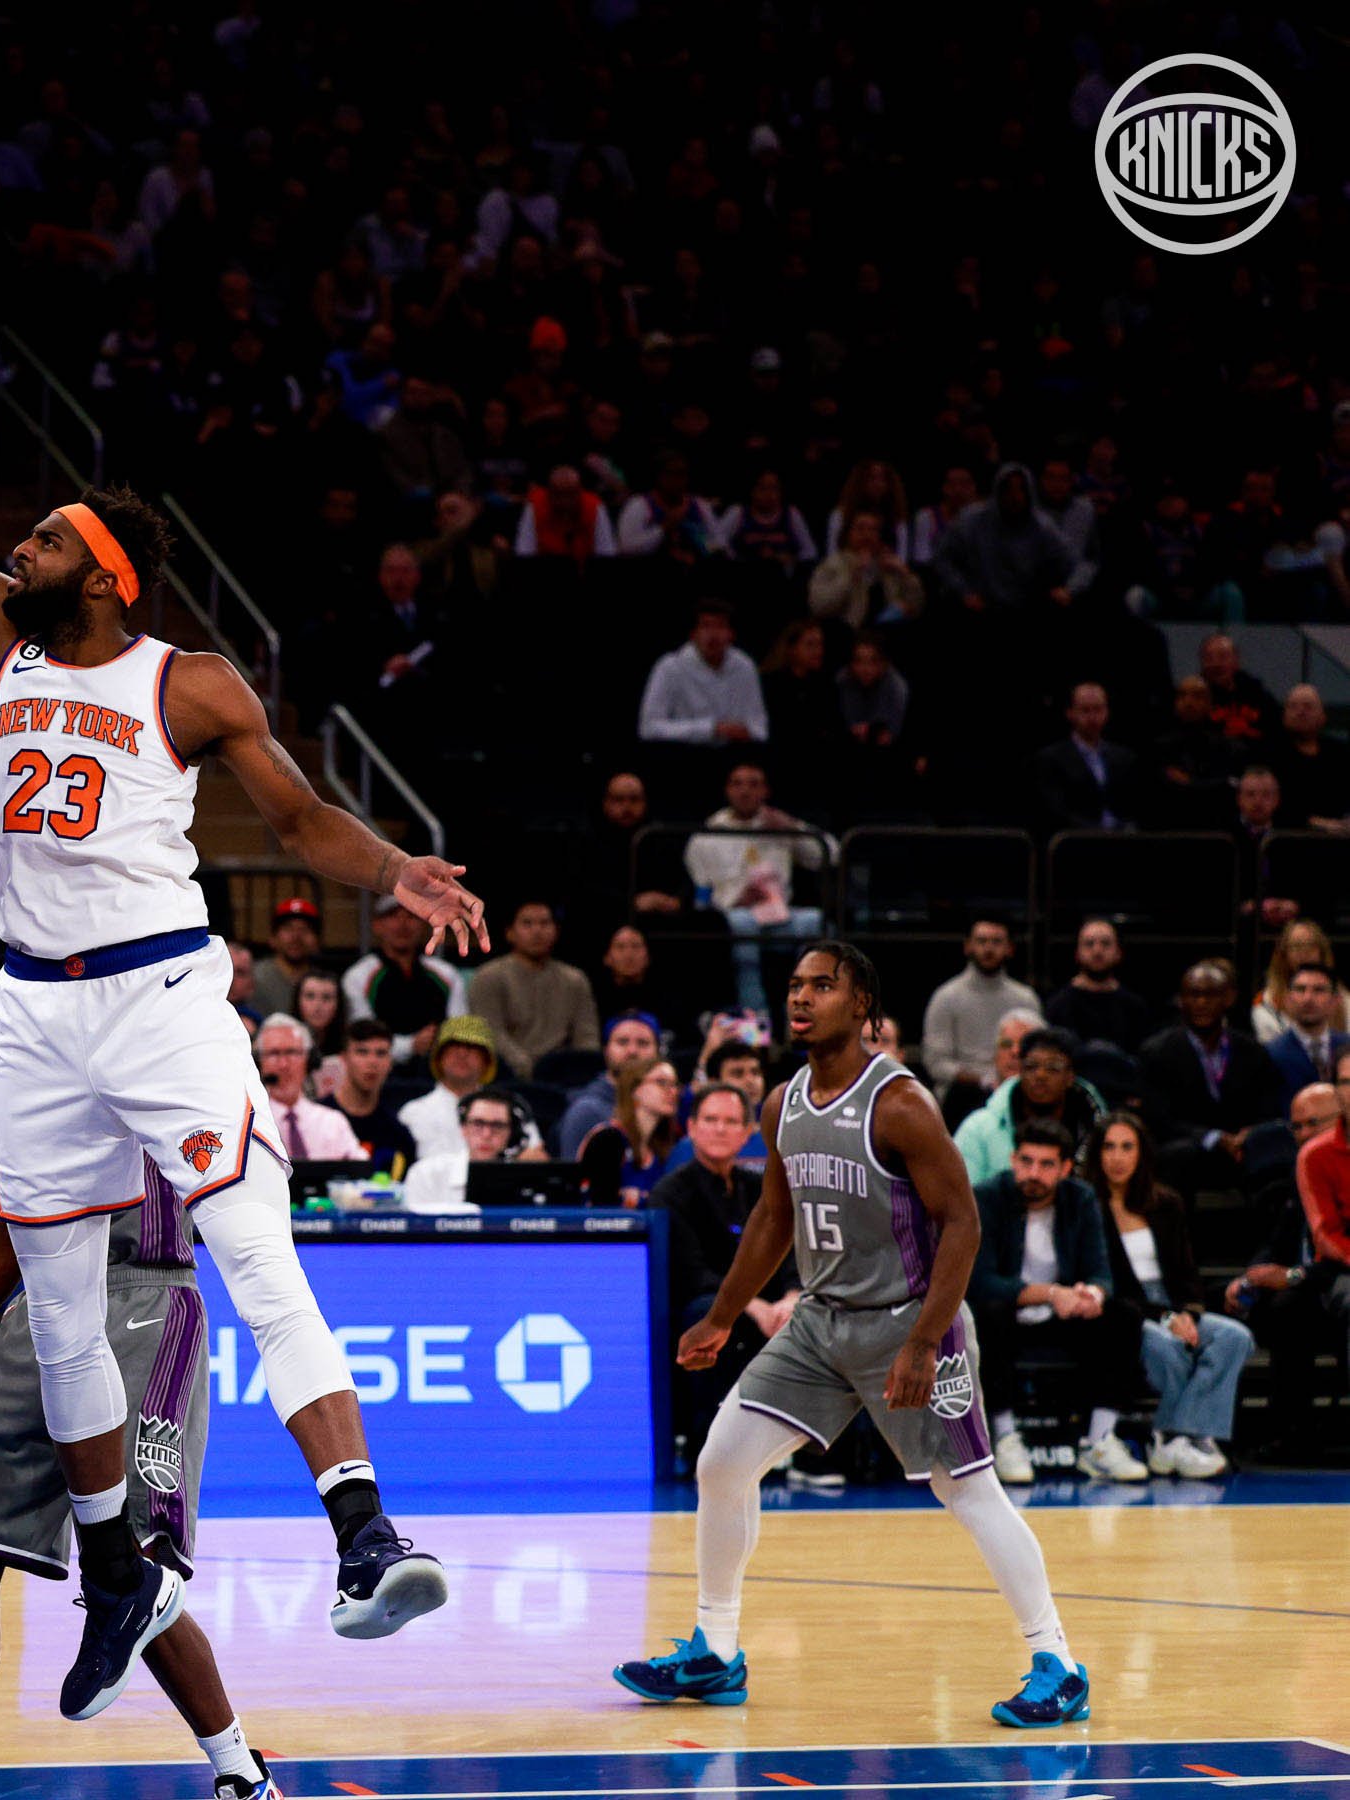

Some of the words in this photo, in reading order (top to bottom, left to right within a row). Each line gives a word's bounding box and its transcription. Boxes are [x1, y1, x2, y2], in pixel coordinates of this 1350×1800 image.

[23, 644, 40, 659] 6
[61, 699, 145, 758] YORK
[2, 748, 107, 841] 23
[800, 1202, 845, 1252] 15
[137, 1443, 181, 1470] KINGS
